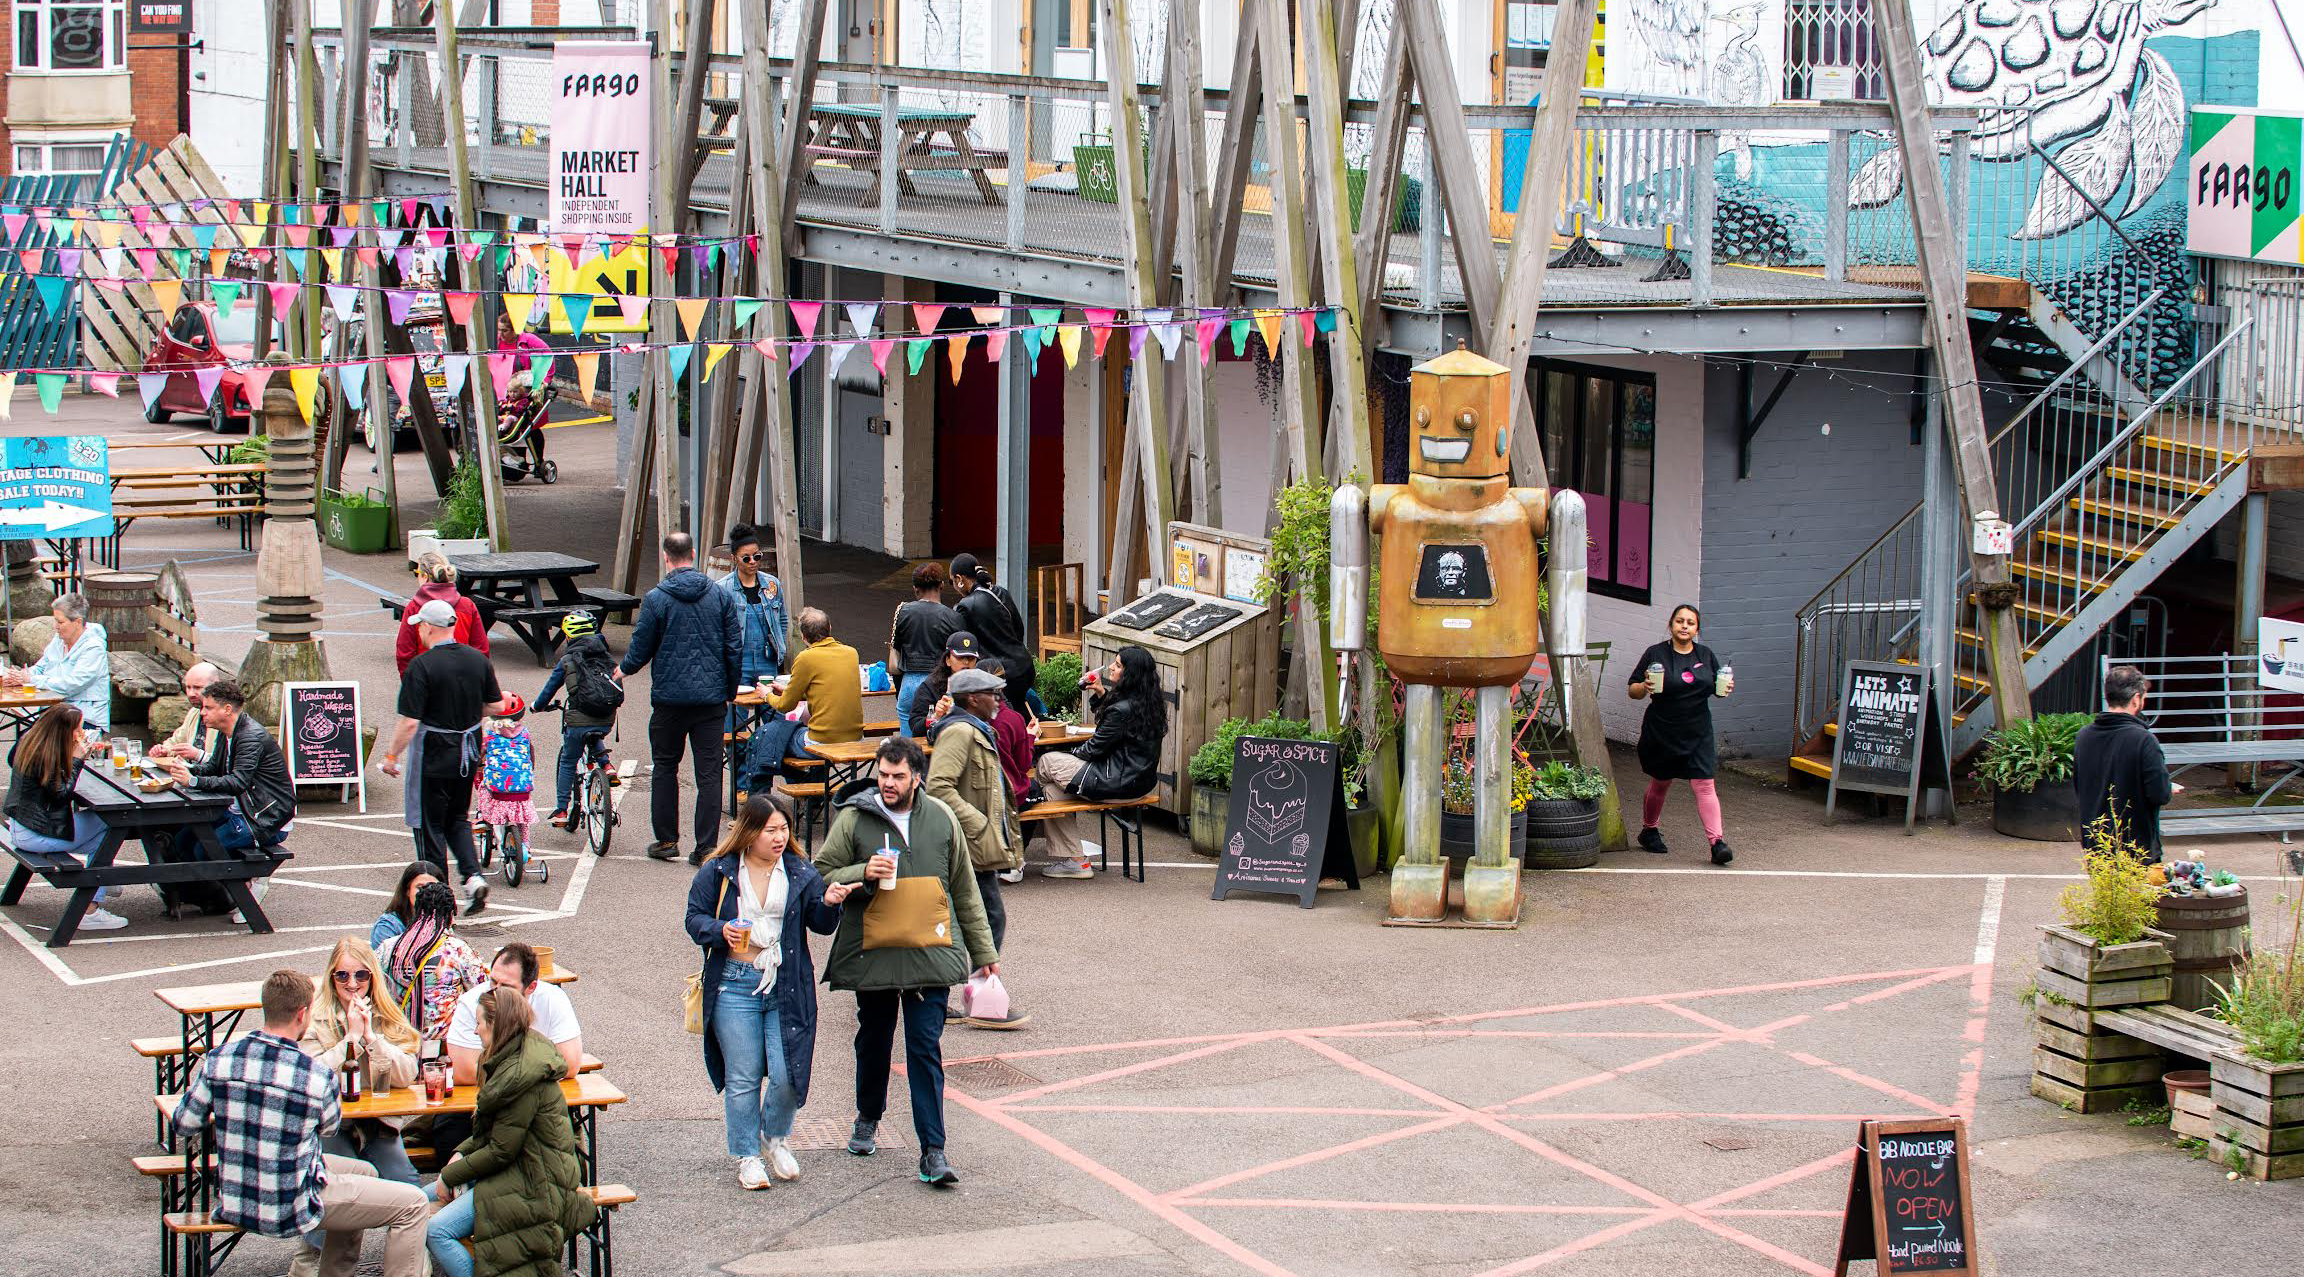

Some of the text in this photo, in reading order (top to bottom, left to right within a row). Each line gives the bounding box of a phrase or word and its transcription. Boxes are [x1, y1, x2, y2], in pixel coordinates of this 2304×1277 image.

[141, 5, 182, 15] CAN YOU FIND
[141, 15, 152, 24] THE
[153, 15, 166, 24] WAY
[563, 73, 639, 98] FARGO
[562, 151, 640, 173] MARKET
[562, 176, 607, 198] HALL
[2198, 161, 2292, 213] FARGO
[562, 200, 619, 212] INDEPENDENT
[562, 213, 632, 224] SHOPPING INSIDE
[36, 468, 105, 486] CLOTHING
[33, 484, 85, 499] TODAY!!
[298, 690, 344, 702] Handmade
[1850, 689, 1920, 714] ANIMATE
[1242, 740, 1330, 764] SUGAR & SPICE
[1862, 742, 1895, 754] OR VISIT
[1899, 1141, 1936, 1157] NOODLE
[1936, 1140, 1956, 1155] BAR
[1885, 1166, 1945, 1189] NOW
[1896, 1196, 1955, 1220] OPEN
[1888, 1241, 1909, 1258] Hand
